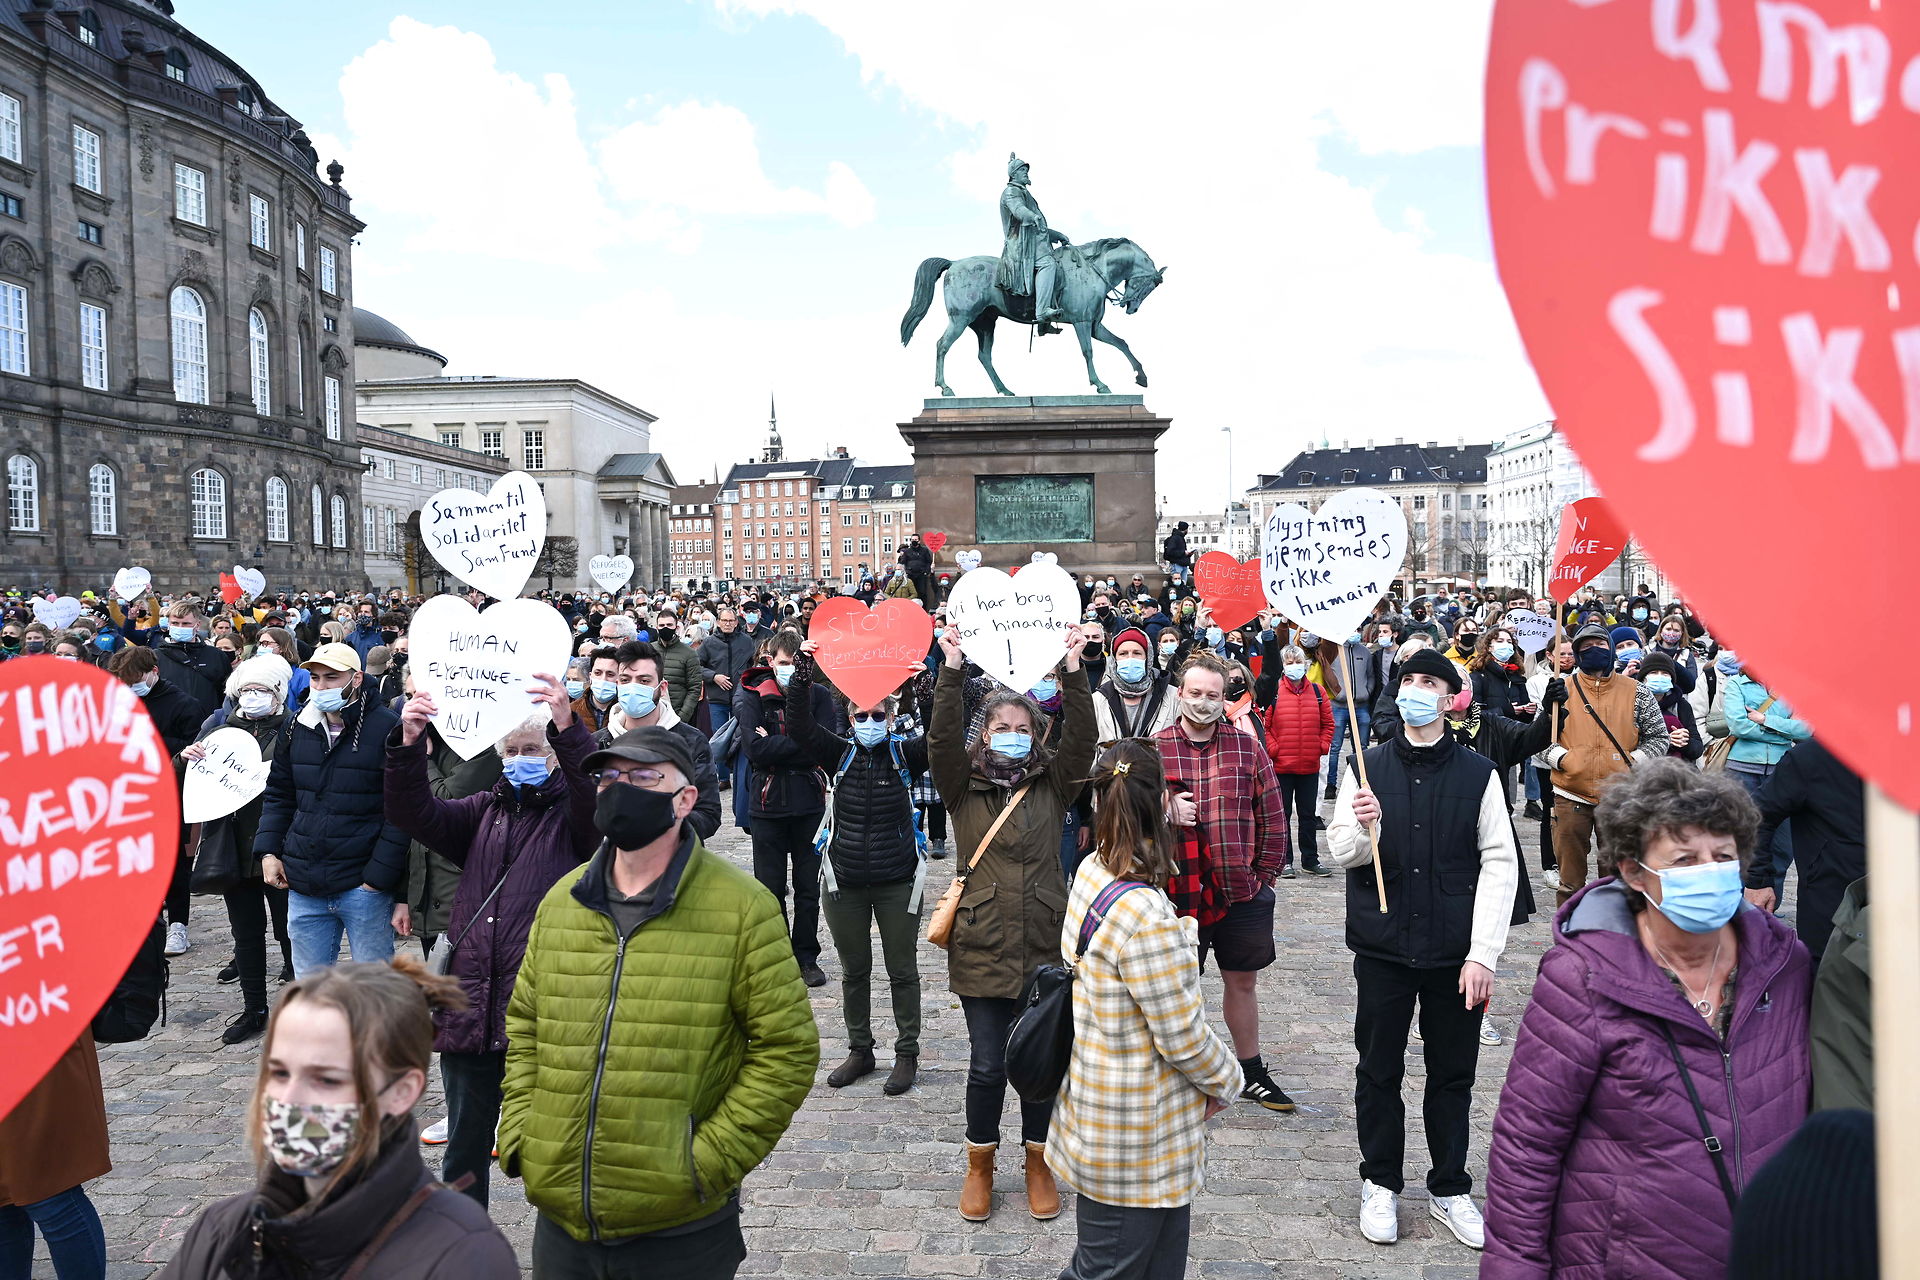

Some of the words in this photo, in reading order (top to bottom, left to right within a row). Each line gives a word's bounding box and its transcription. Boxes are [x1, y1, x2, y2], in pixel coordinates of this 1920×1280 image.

[432, 500, 504, 524] Sammen
[506, 483, 525, 508] til
[591, 559, 628, 570] REFUGEES
[976, 594, 1006, 611] har
[1015, 592, 1054, 612] brug
[1295, 581, 1378, 616] humain
[828, 605, 900, 642] STOP
[449, 631, 518, 655] HUMAN
[444, 685, 497, 702] POLITIK
[222, 751, 249, 774] har
[0, 831, 155, 897] NDEN
